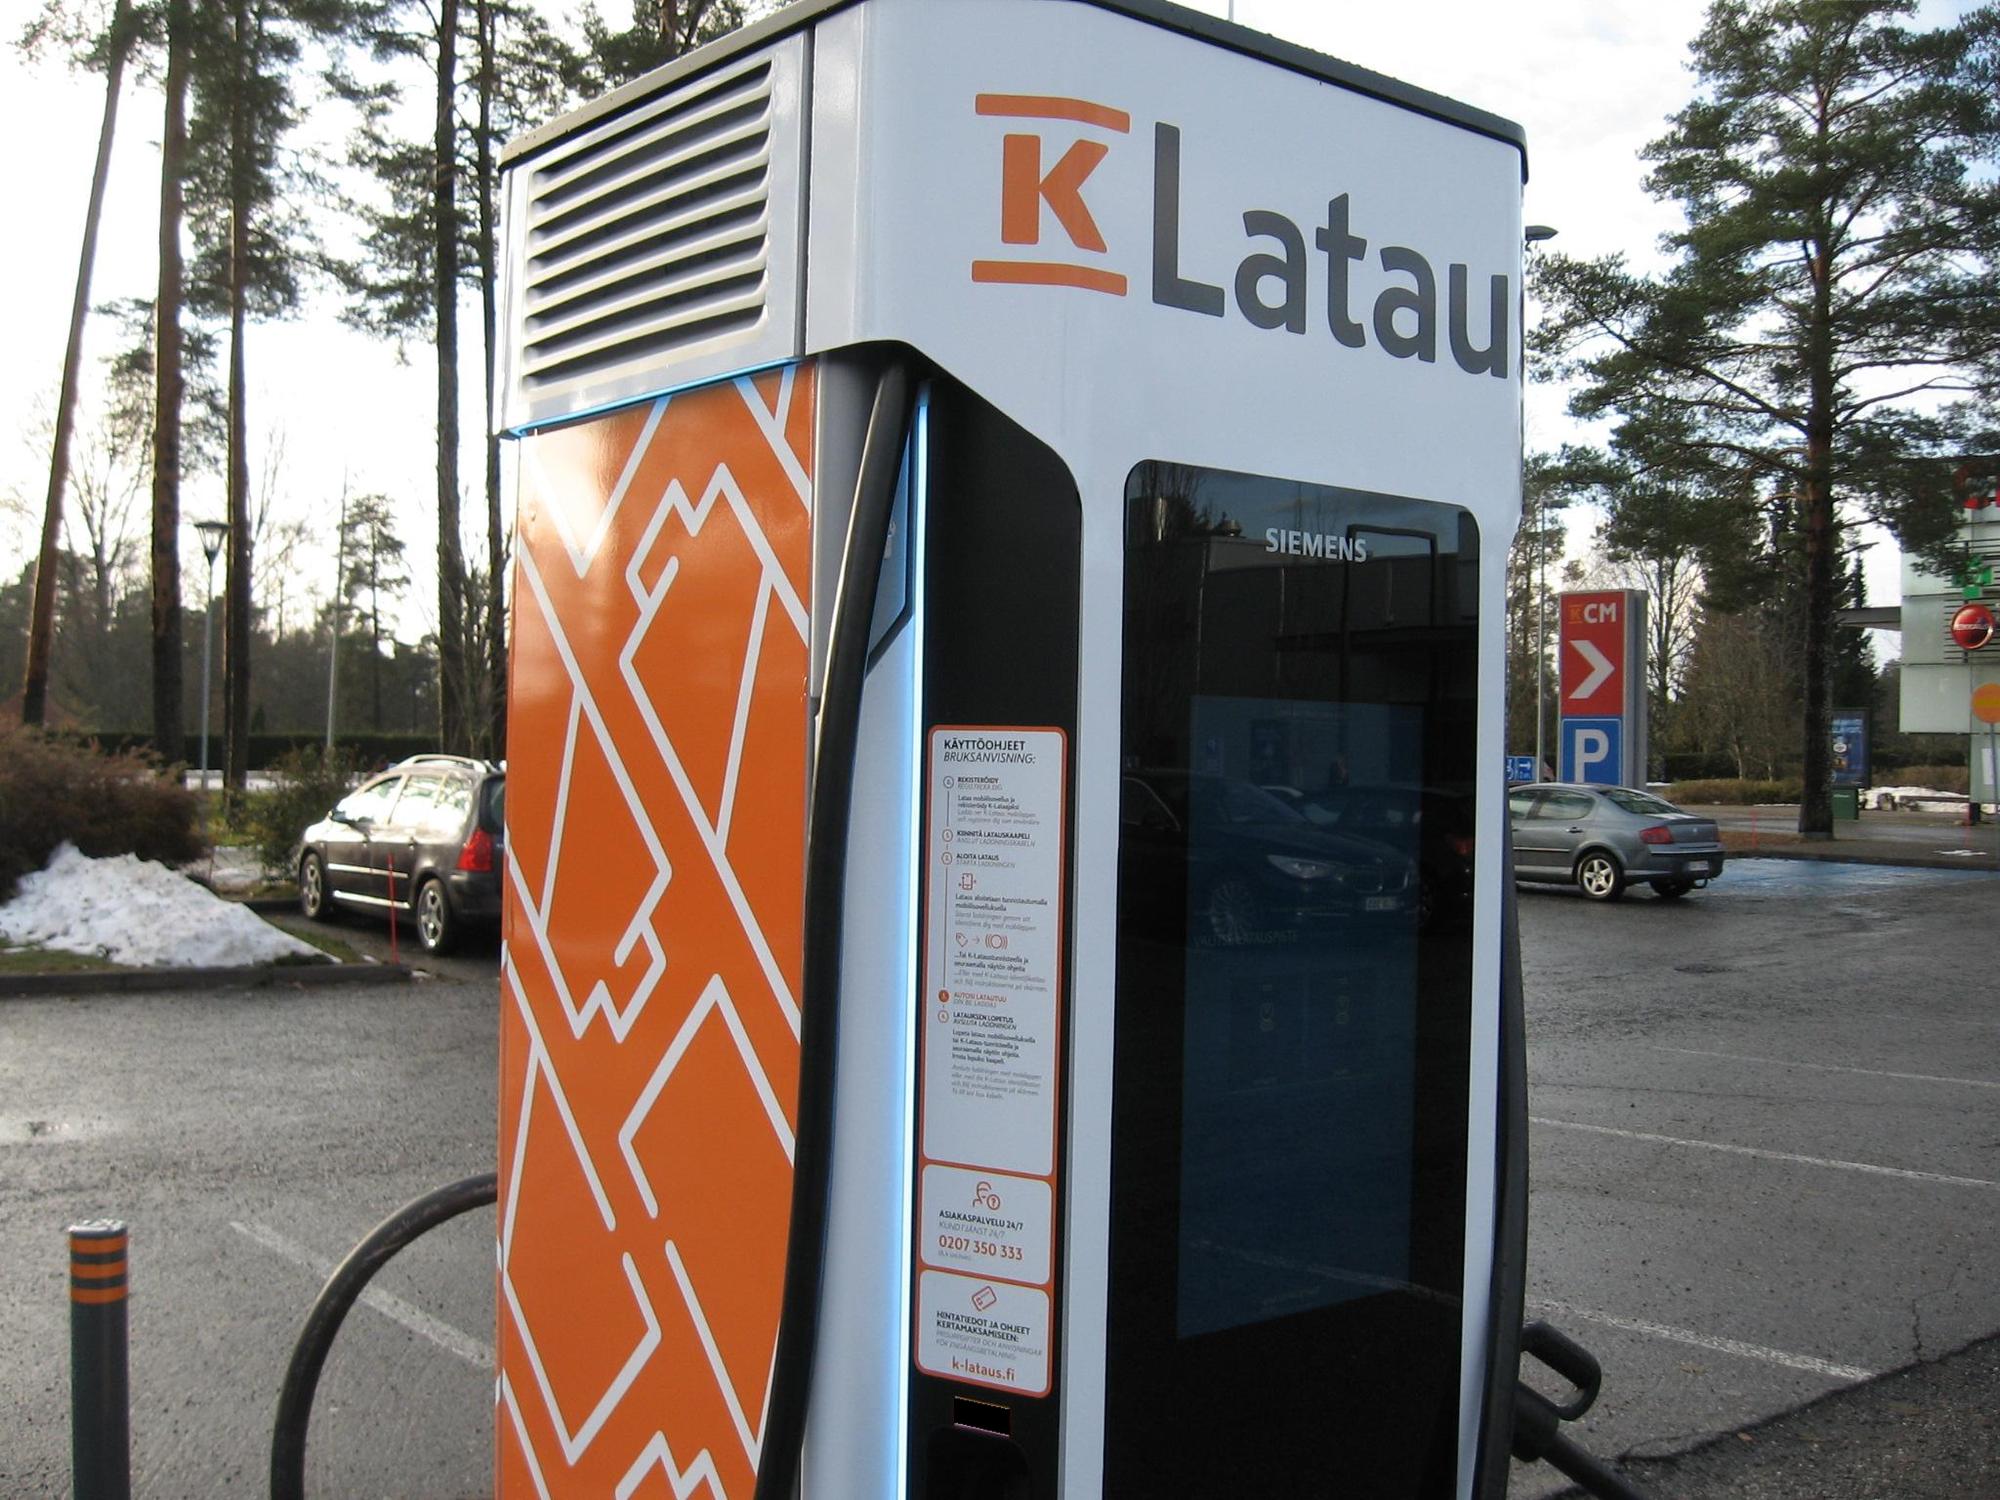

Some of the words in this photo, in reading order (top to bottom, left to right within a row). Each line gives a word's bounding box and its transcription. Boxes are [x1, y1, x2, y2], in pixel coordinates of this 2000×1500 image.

[1265, 527, 1367, 563] SIEMENS
[943, 738, 1026, 751] KÄYTTÖOHJEET
[1574, 729, 1610, 783] P
[943, 751, 1037, 764] BRUKSANVISNING:
[939, 1210, 1005, 1228] ASIAKASPALVELU
[1006, 1220, 1024, 1231] 24/7
[938, 1235, 970, 1252] 0207
[972, 1240, 997, 1256] 350
[1000, 1245, 1023, 1260] 333
[936, 1311, 989, 1327] HINTATIEDOT
[989, 1320, 999, 1329] JA
[1000, 1323, 1031, 1335] OHJEET
[952, 1355, 1015, 1381] k-lataus.fi
